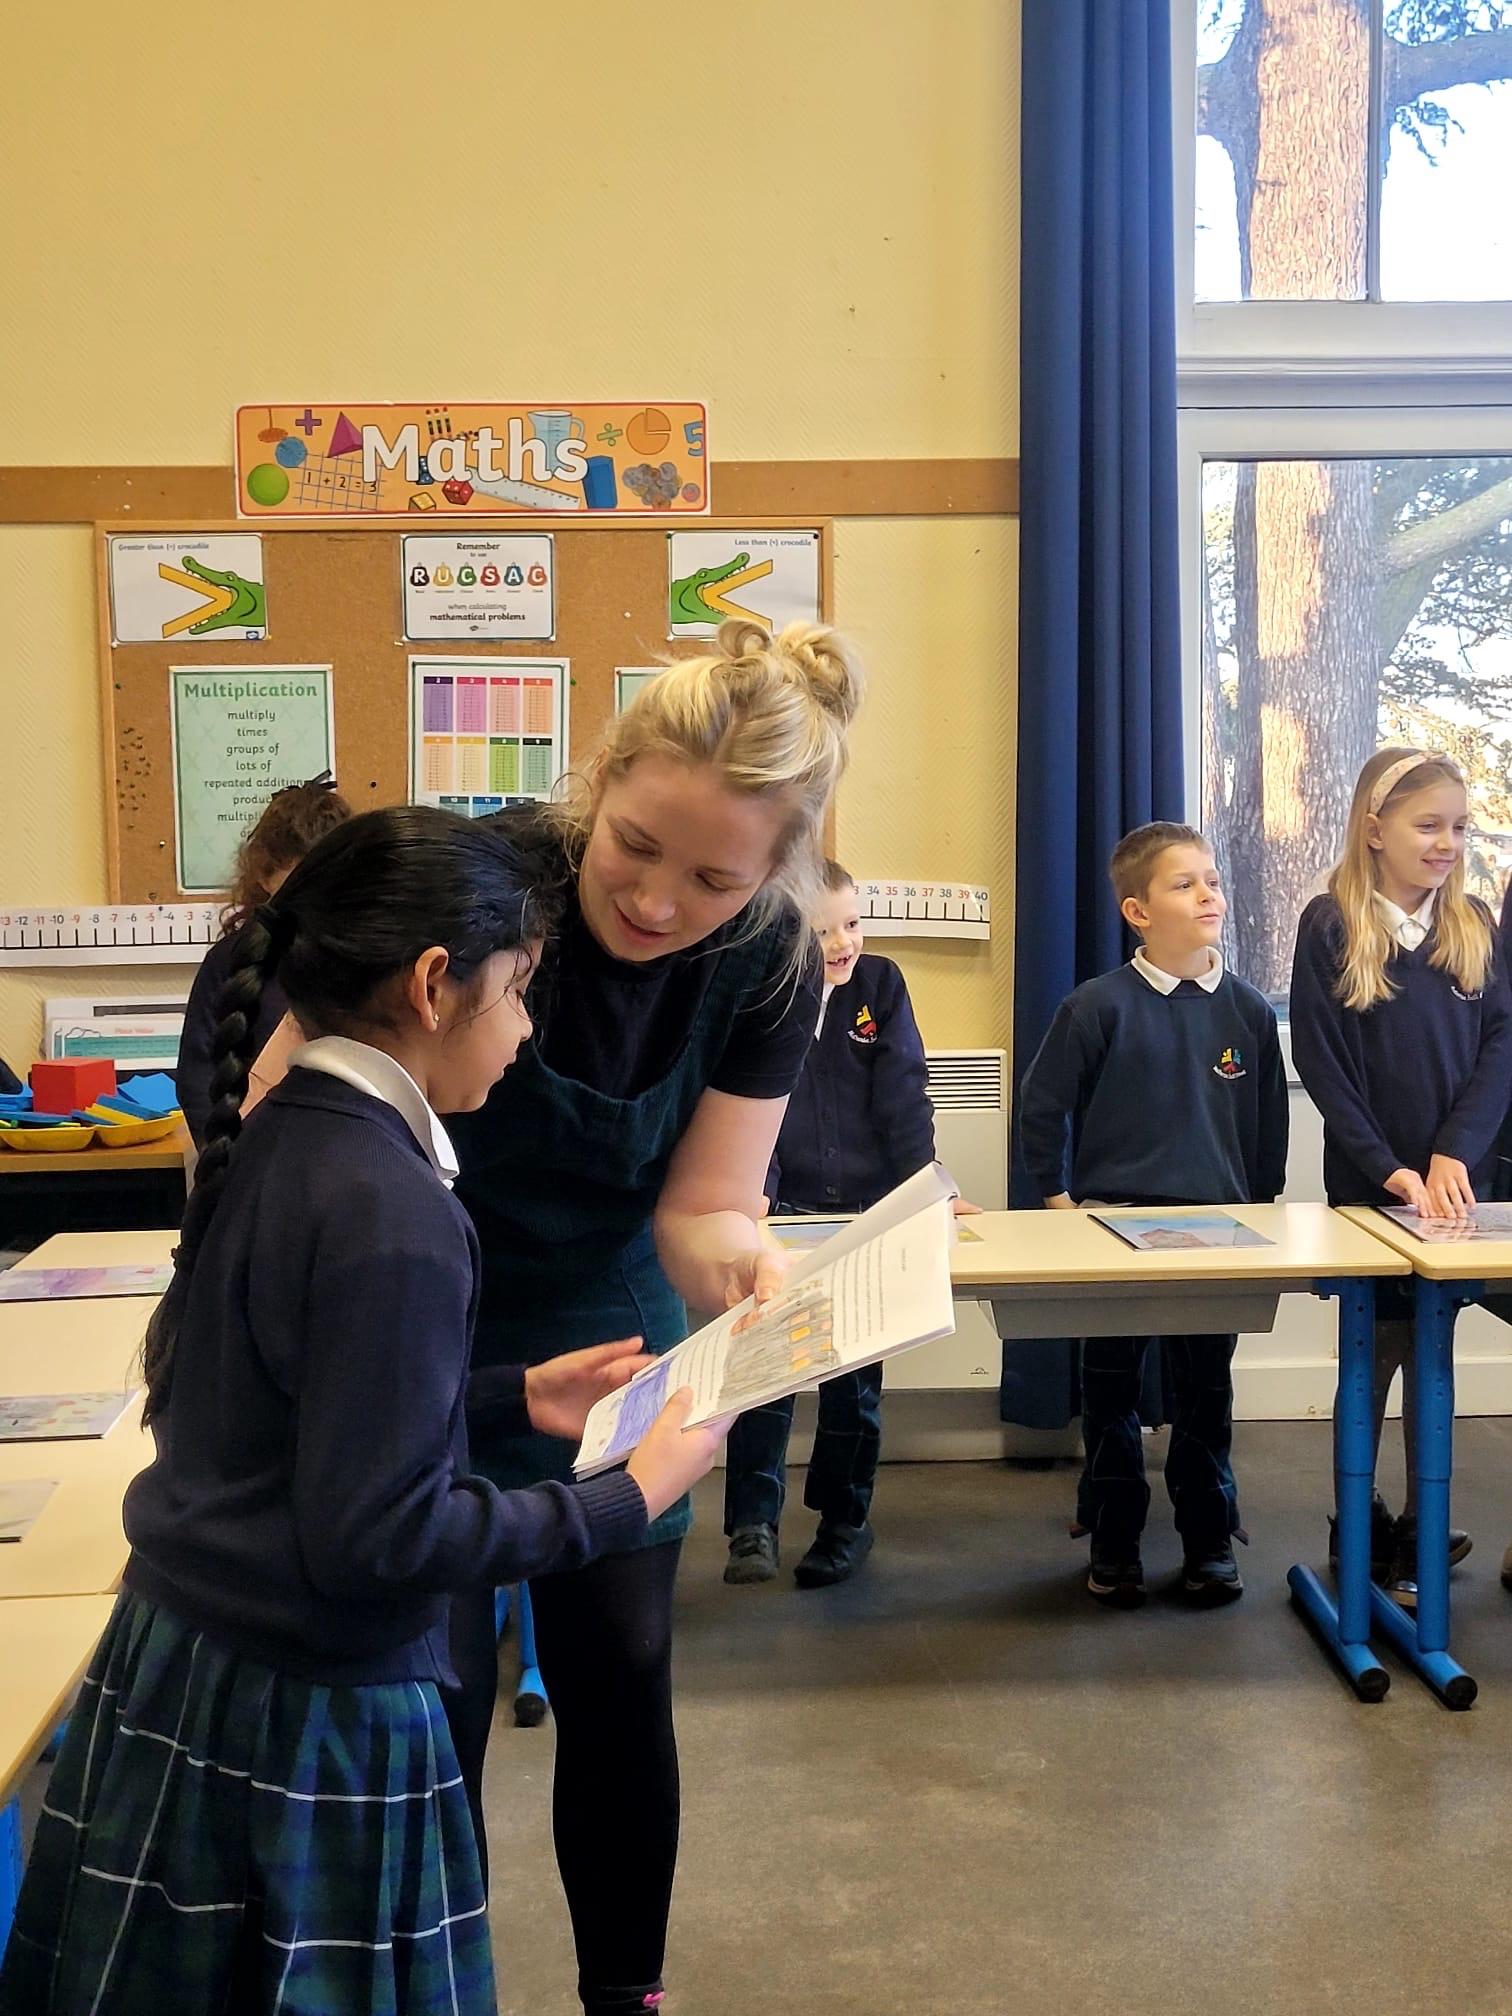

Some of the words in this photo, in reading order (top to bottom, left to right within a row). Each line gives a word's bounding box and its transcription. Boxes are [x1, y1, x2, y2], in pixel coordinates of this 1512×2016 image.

[361, 418, 589, 483] Maths
[339, 476, 346, 488] 2
[369, 481, 377, 492] 3
[456, 541, 501, 550] Remember
[468, 603, 507, 611] calculating
[488, 613, 526, 622] problems
[184, 682, 318, 701] Multiplication
[227, 709, 276, 722] multiply
[237, 728, 268, 737] times
[226, 745, 265, 757] groups
[268, 743, 280, 756] of
[236, 759, 257, 771] lots
[260, 760, 272, 772] of
[205, 777, 252, 789] repeated
[256, 777, 304, 788] addition
[233, 795, 273, 807] produc
[866, 886, 880, 896] 34
[885, 886, 898, 896] 35
[904, 887, 917, 897] 36
[922, 888, 934, 897] 37
[939, 888, 952, 898] 38
[958, 890, 970, 899] 39
[974, 891, 988, 901] 40
[15, 916, 29, 926] -12
[33, 916, 45, 925] -11
[50, 914, 65, 924] -10
[71, 914, 81, 923] -9
[89, 913, 100, 923] -8
[110, 913, 119, 923] -7
[126, 912, 137, 922] -6
[163, 911, 174, 920] -4
[184, 911, 193, 920] -3
[202, 910, 212, 920] -2
